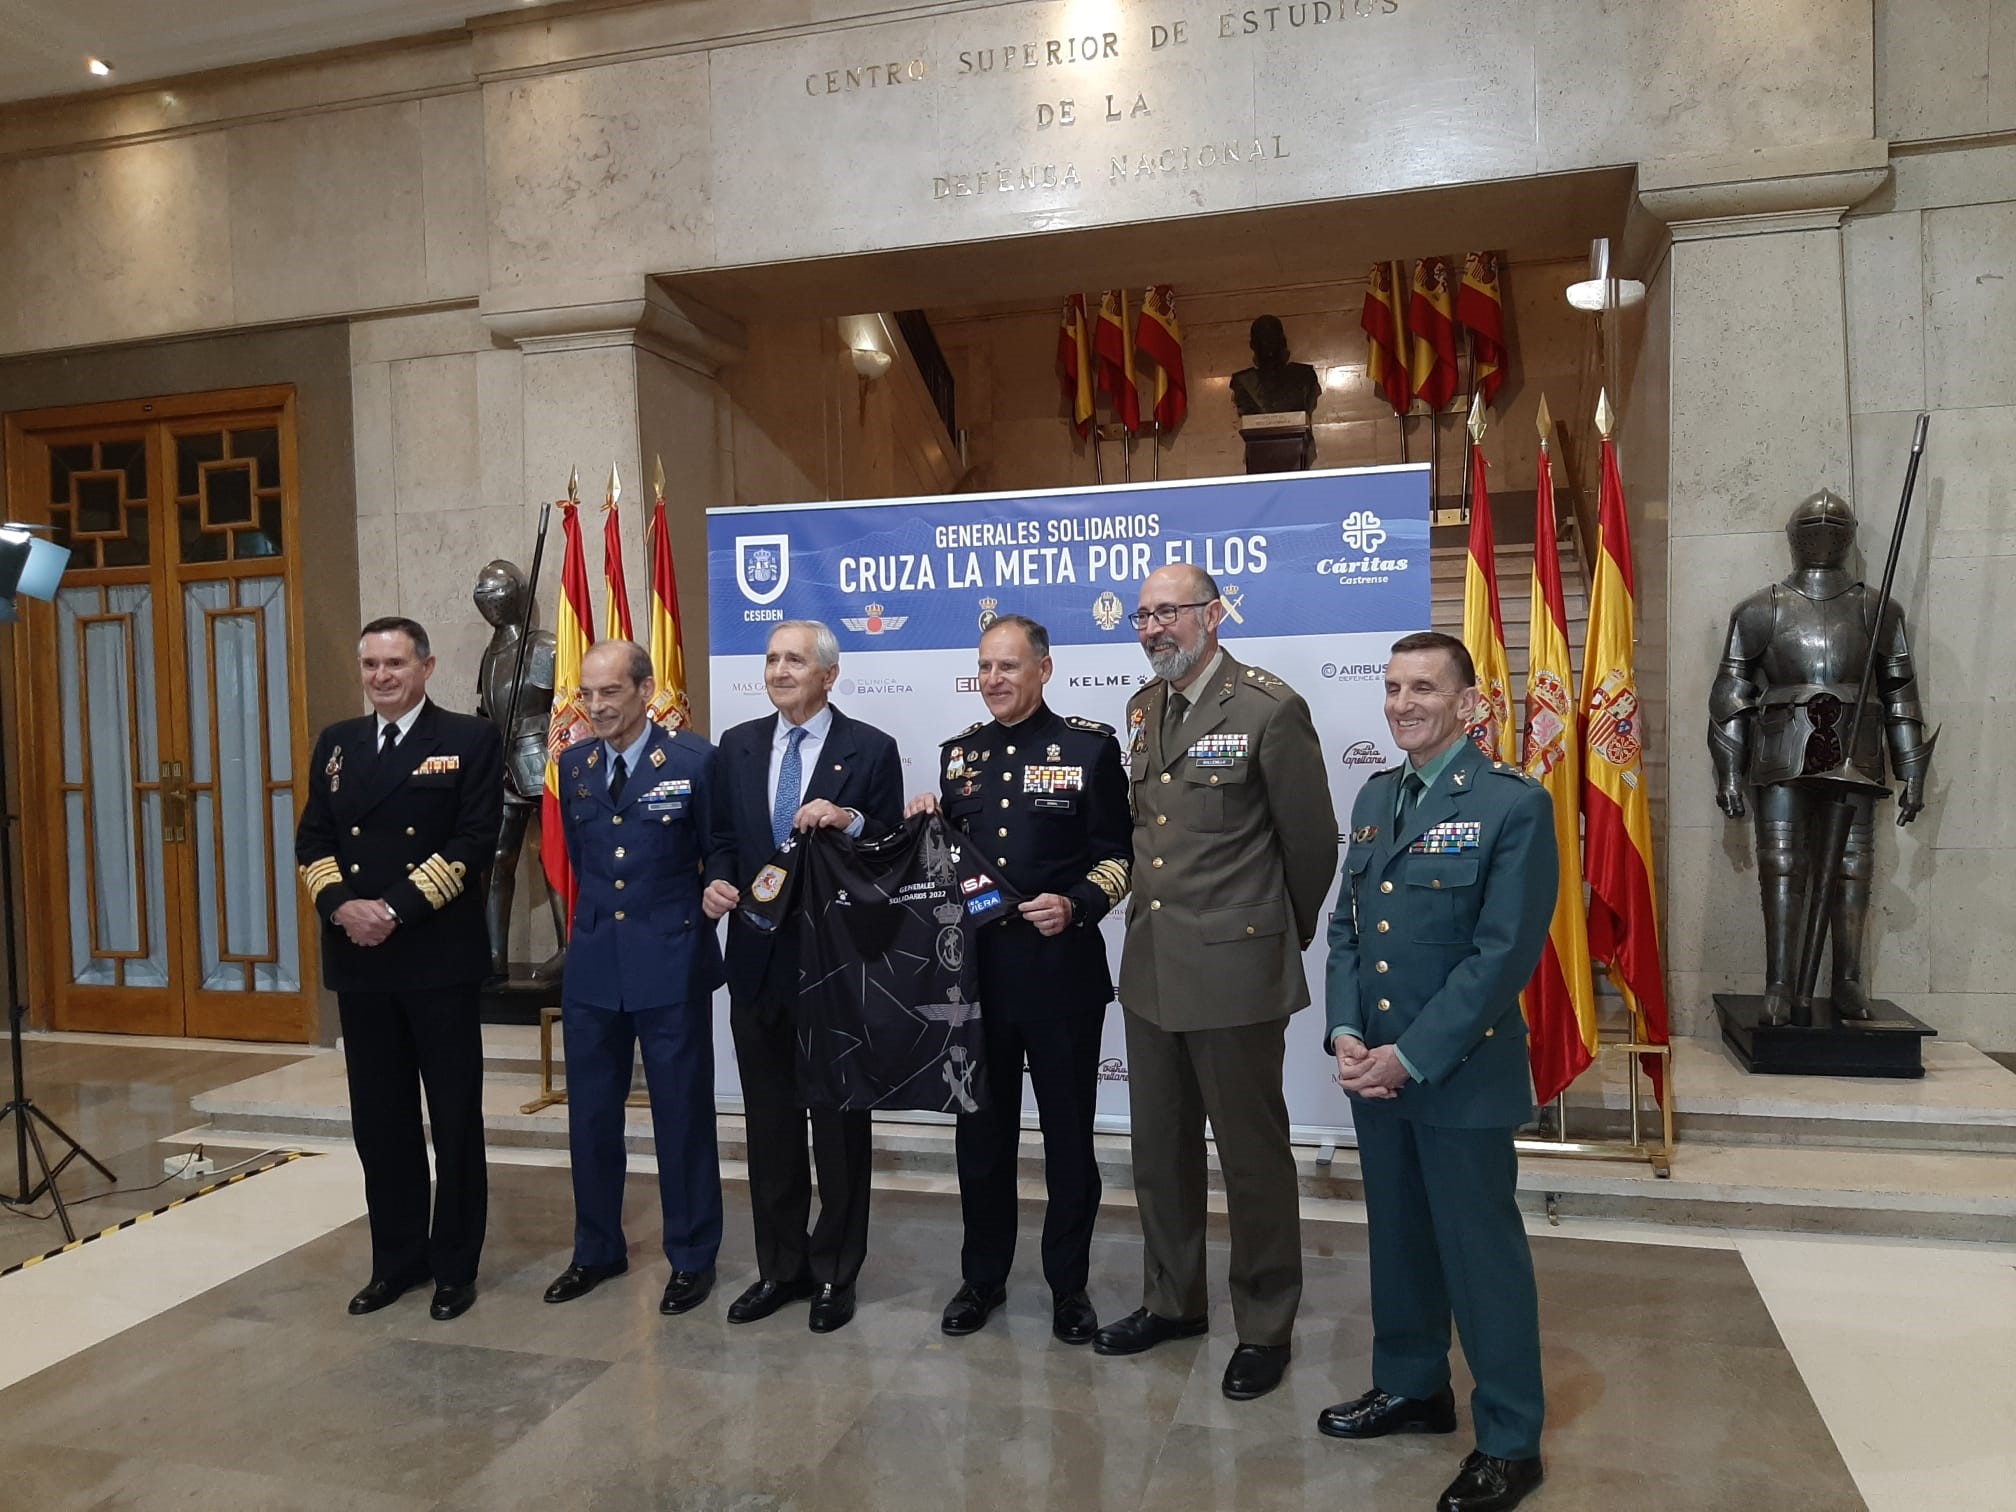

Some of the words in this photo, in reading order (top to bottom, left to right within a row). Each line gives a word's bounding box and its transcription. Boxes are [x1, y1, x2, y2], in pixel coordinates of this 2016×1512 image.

[805, 59, 925, 96] CENTRO
[958, 32, 1119, 75] SUPERIOR
[1151, 21, 1188, 49] DE
[1218, 0, 1399, 39] ESTUDIOS
[1036, 98, 1076, 129] DE
[1104, 91, 1151, 121] LA
[932, 161, 1081, 200] DEFENSA
[1109, 134, 1291, 183] NACIONAL
[935, 521, 1040, 548] GENERALES
[1047, 514, 1160, 543] SOLIDARIOS
[839, 553, 936, 593] CRUZA
[947, 551, 983, 588] LA
[995, 547, 1076, 586] META
[1089, 542, 1151, 582] POR
[1316, 556, 1409, 575] Cáritas
[1339, 575, 1389, 585] Castrense
[744, 609, 784, 622] CESEDEN
[1340, 664, 1389, 675] AIRBUS
[1069, 675, 1131, 687] KELME
[857, 685, 913, 694] BAVIERA
[929, 890, 947, 899] 2022
